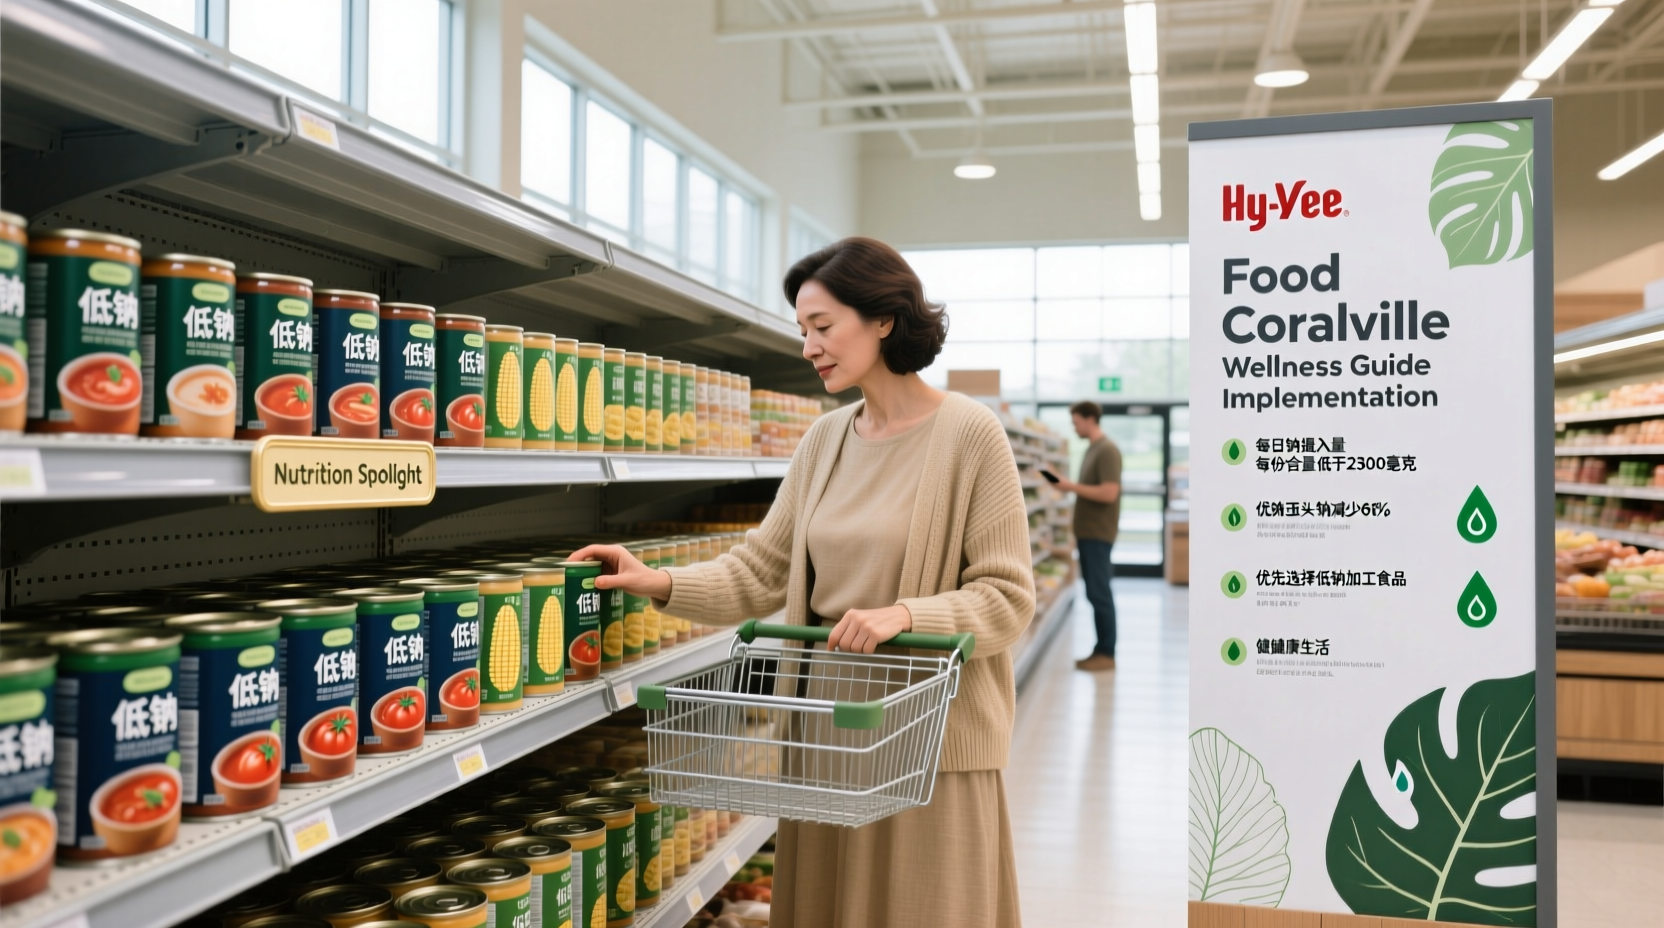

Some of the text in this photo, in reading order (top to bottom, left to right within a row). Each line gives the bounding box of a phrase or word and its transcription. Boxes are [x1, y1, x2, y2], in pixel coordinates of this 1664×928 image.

[1223, 252, 1340, 295] Food
[78, 286, 139, 330] 低钠
[183, 305, 235, 342] 低钠
[1222, 300, 1450, 344] Coralville
[270, 319, 313, 352] 低钠
[1222, 353, 1432, 379] Wellness Guide
[1223, 384, 1439, 413] Implementation
[274, 462, 353, 485] Nutrition
[314, 649, 357, 686] 低钠
[384, 633, 424, 666] 低钠
[228, 667, 279, 709] 低钠
[111, 692, 178, 742] 低钠
